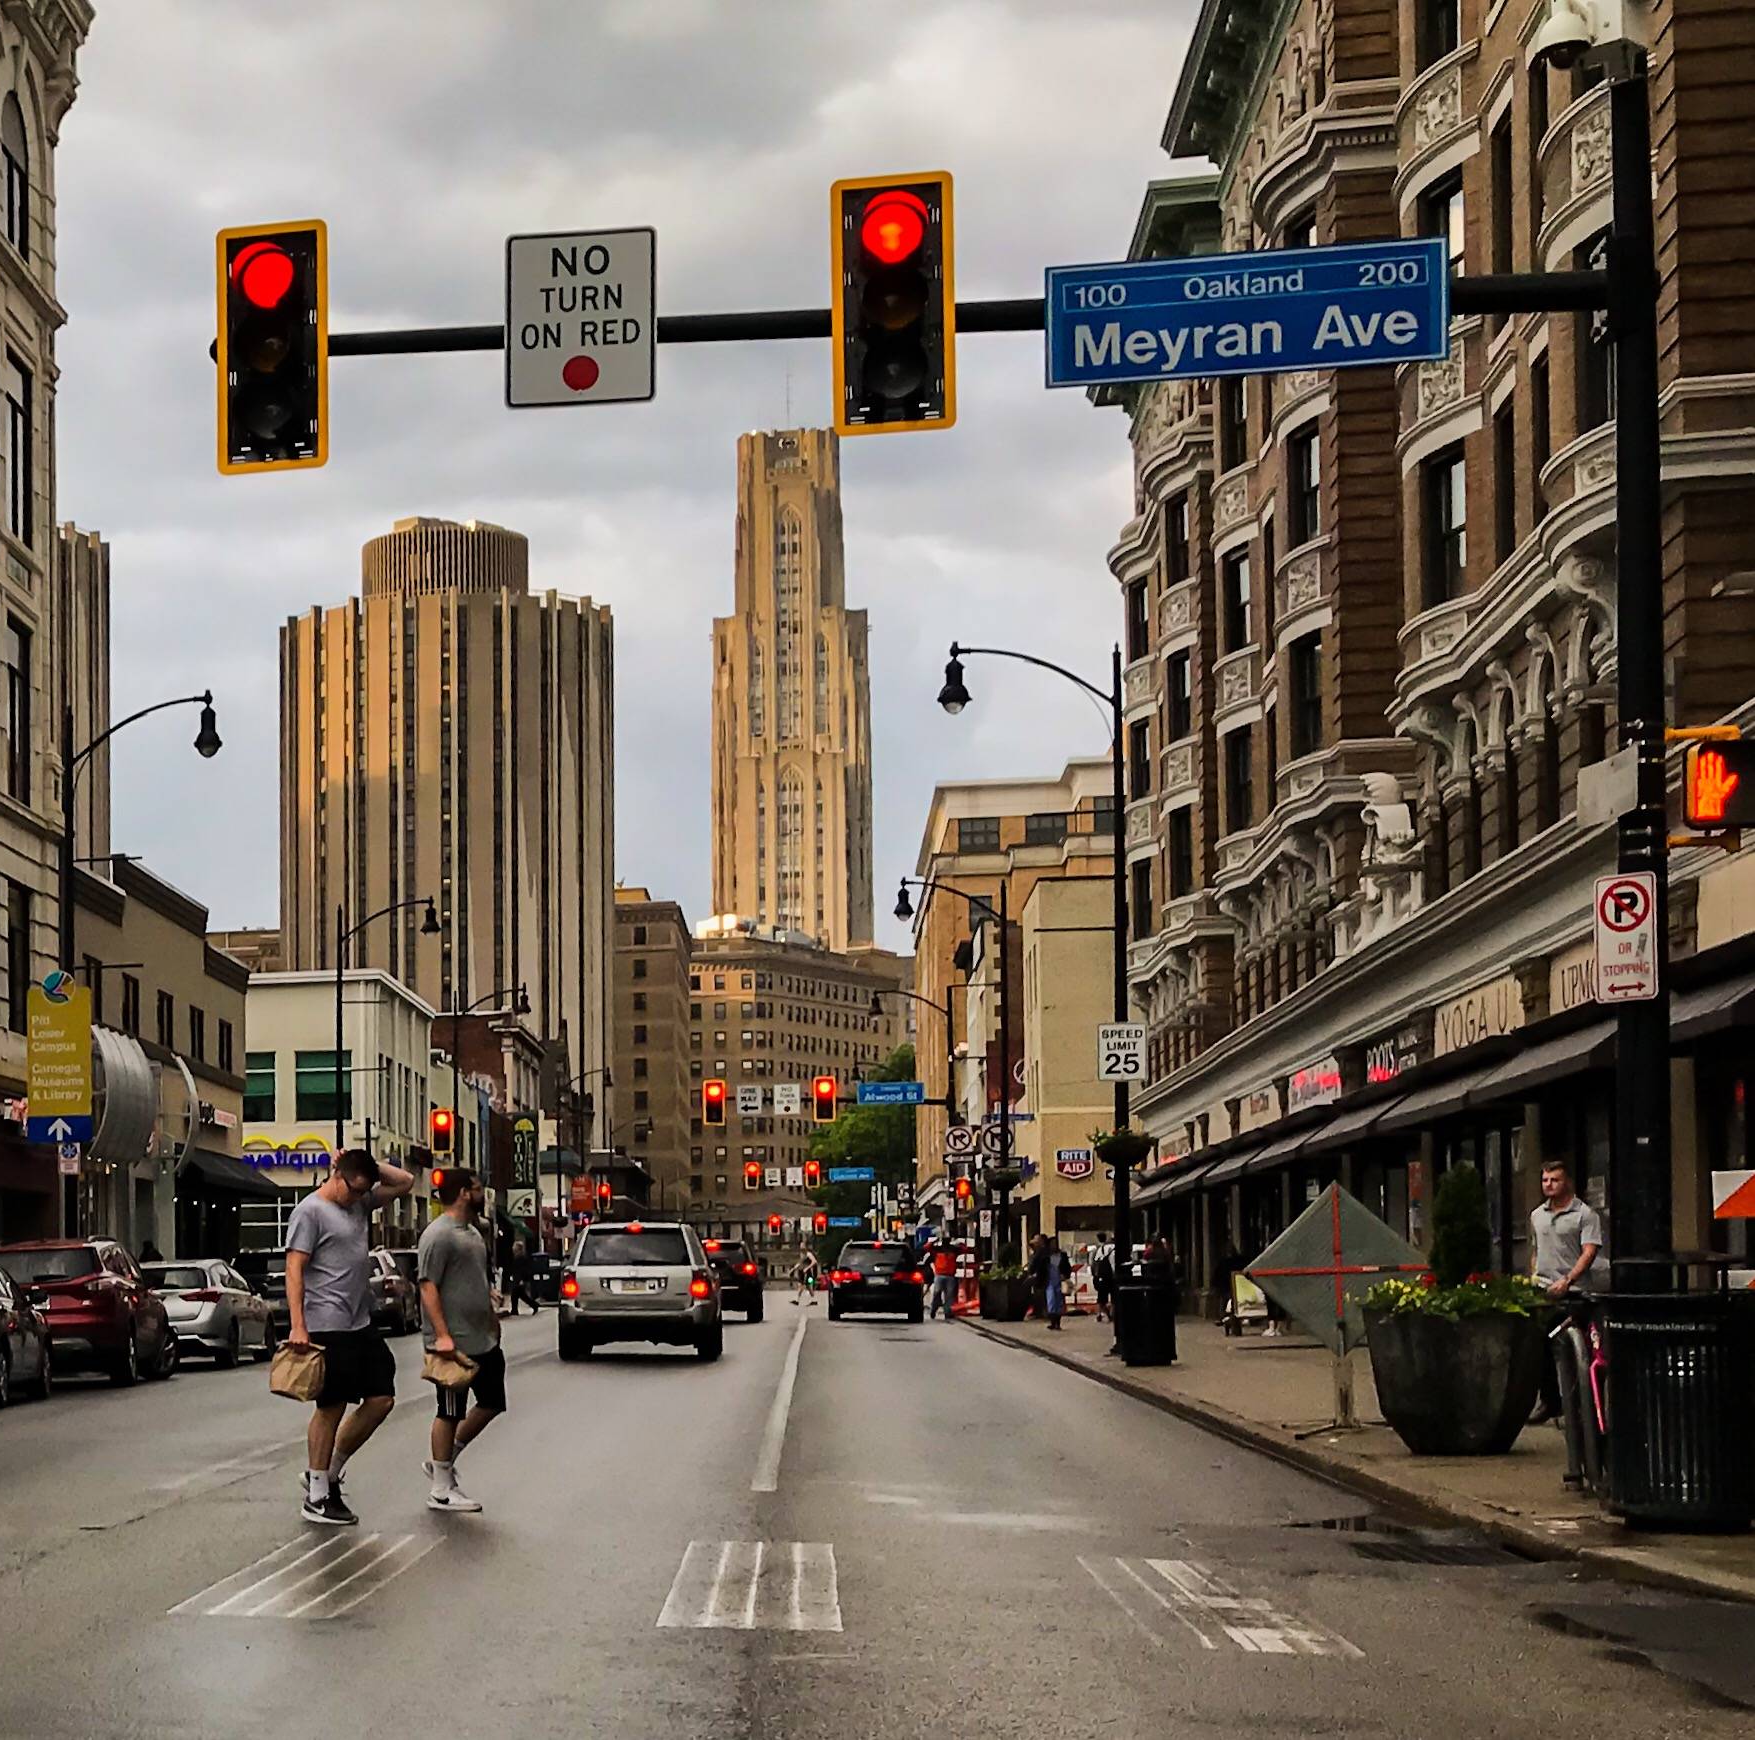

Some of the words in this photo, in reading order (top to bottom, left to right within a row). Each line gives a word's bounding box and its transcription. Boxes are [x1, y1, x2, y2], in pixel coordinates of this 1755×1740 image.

[551, 245, 610, 277] NO
[1074, 283, 1127, 308] 100
[1183, 269, 1304, 301] Oakland
[1358, 260, 1418, 287] 200
[540, 283, 623, 313] TURN
[521, 322, 561, 350] ON
[580, 318, 641, 347] RED
[1074, 320, 1283, 373] Meyran
[1312, 304, 1420, 351] Ave
[1618, 942, 1632, 955] OR
[1603, 961, 1650, 977] STOPPING
[31, 1015, 50, 1026] Pitt
[1441, 995, 1489, 1053] YOGA
[31, 1029, 65, 1040] Lower
[1101, 1029, 1143, 1039] SPEED
[31, 1042, 77, 1053] Campus
[1106, 1041, 1137, 1051] LIMIT
[31, 1063, 82, 1075] Carnegie
[1105, 1053, 1140, 1075] 25
[31, 1076, 85, 1087] Museums
[44, 1089, 83, 1102] Library
[864, 1091, 903, 1101] Atwood
[1060, 1151, 1088, 1161] RITE
[1062, 1163, 1086, 1174] AID
